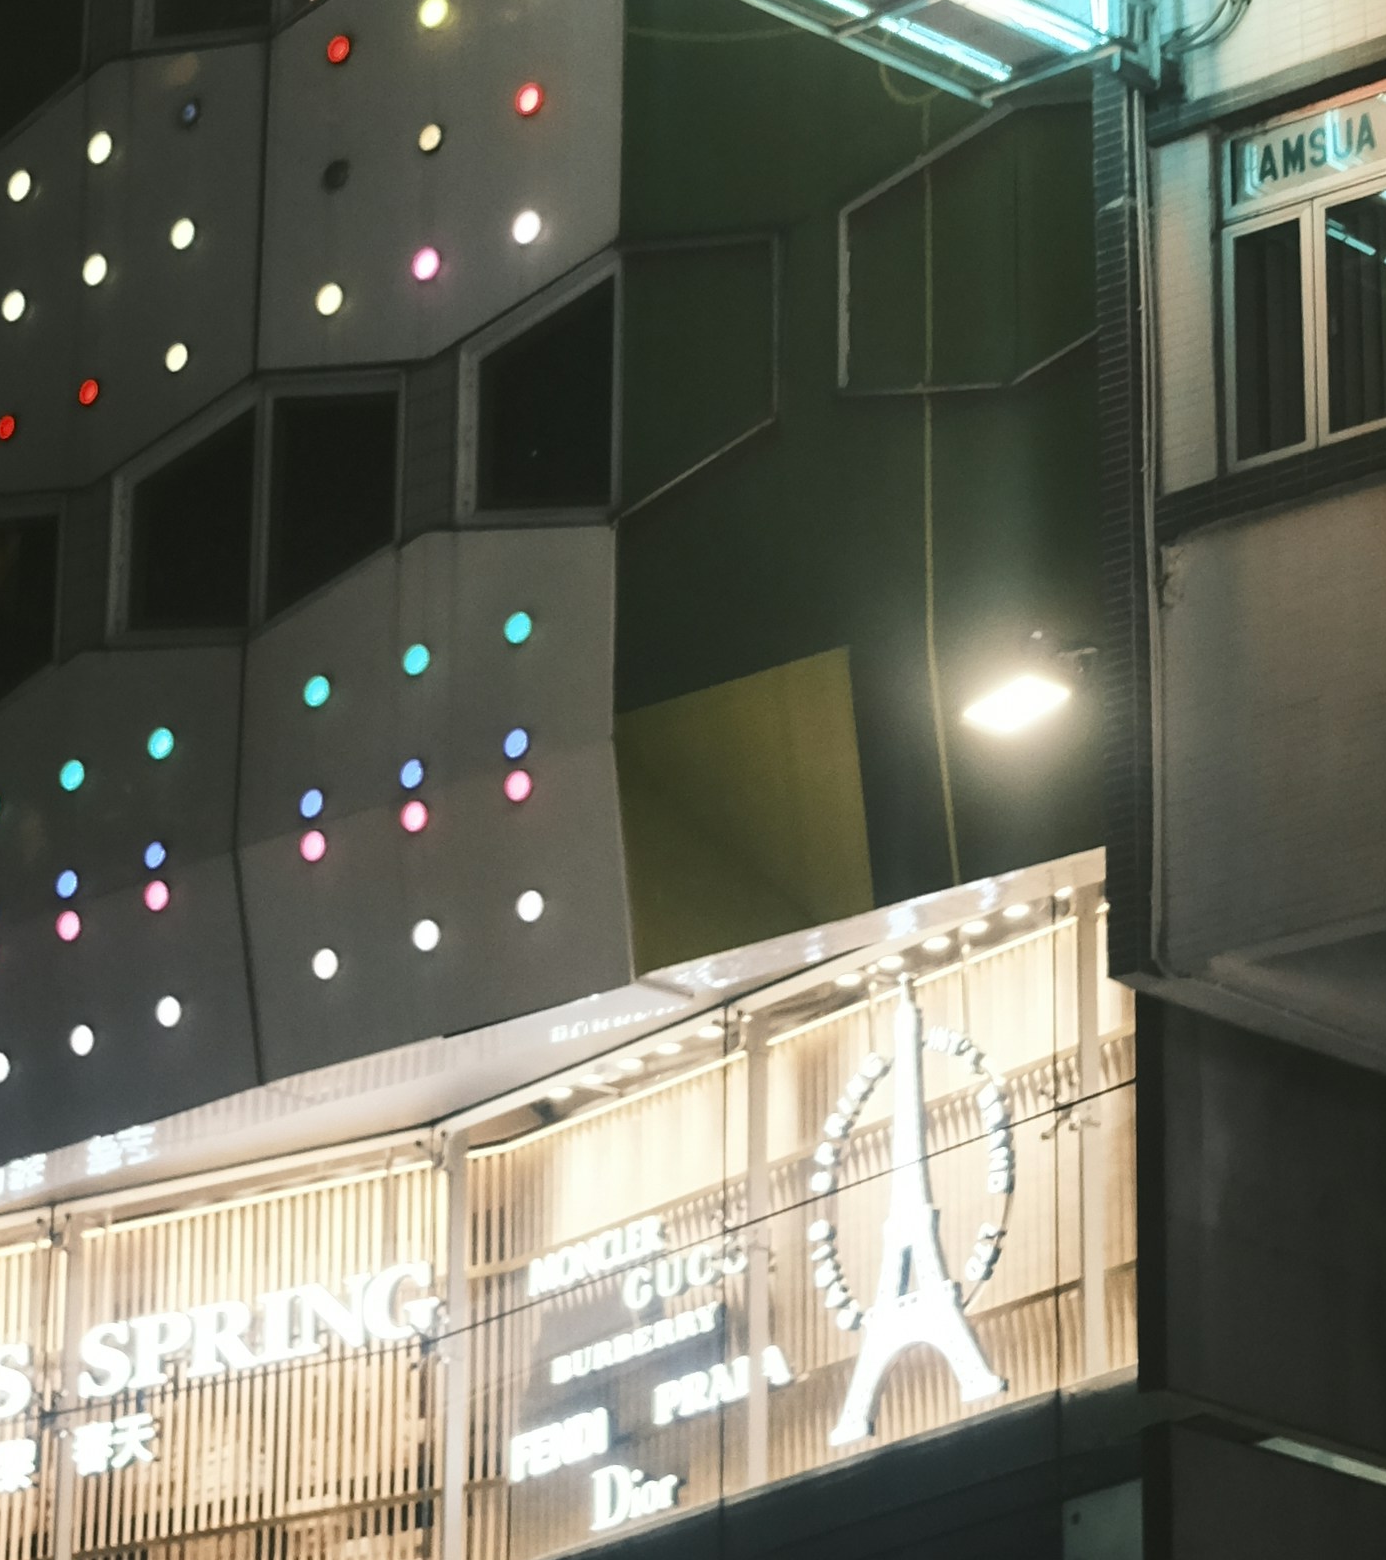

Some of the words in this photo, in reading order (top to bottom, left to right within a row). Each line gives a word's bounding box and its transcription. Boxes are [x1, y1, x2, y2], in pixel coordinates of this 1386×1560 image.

[1257, 109, 1376, 185] AMSUA
[527, 1215, 666, 1297] MONCLER
[76, 1260, 446, 1401] SPRING
[550, 1301, 725, 1385] BURBERRY
[509, 1406, 609, 1483] FENDI
[590, 1463, 680, 1533] Dior
